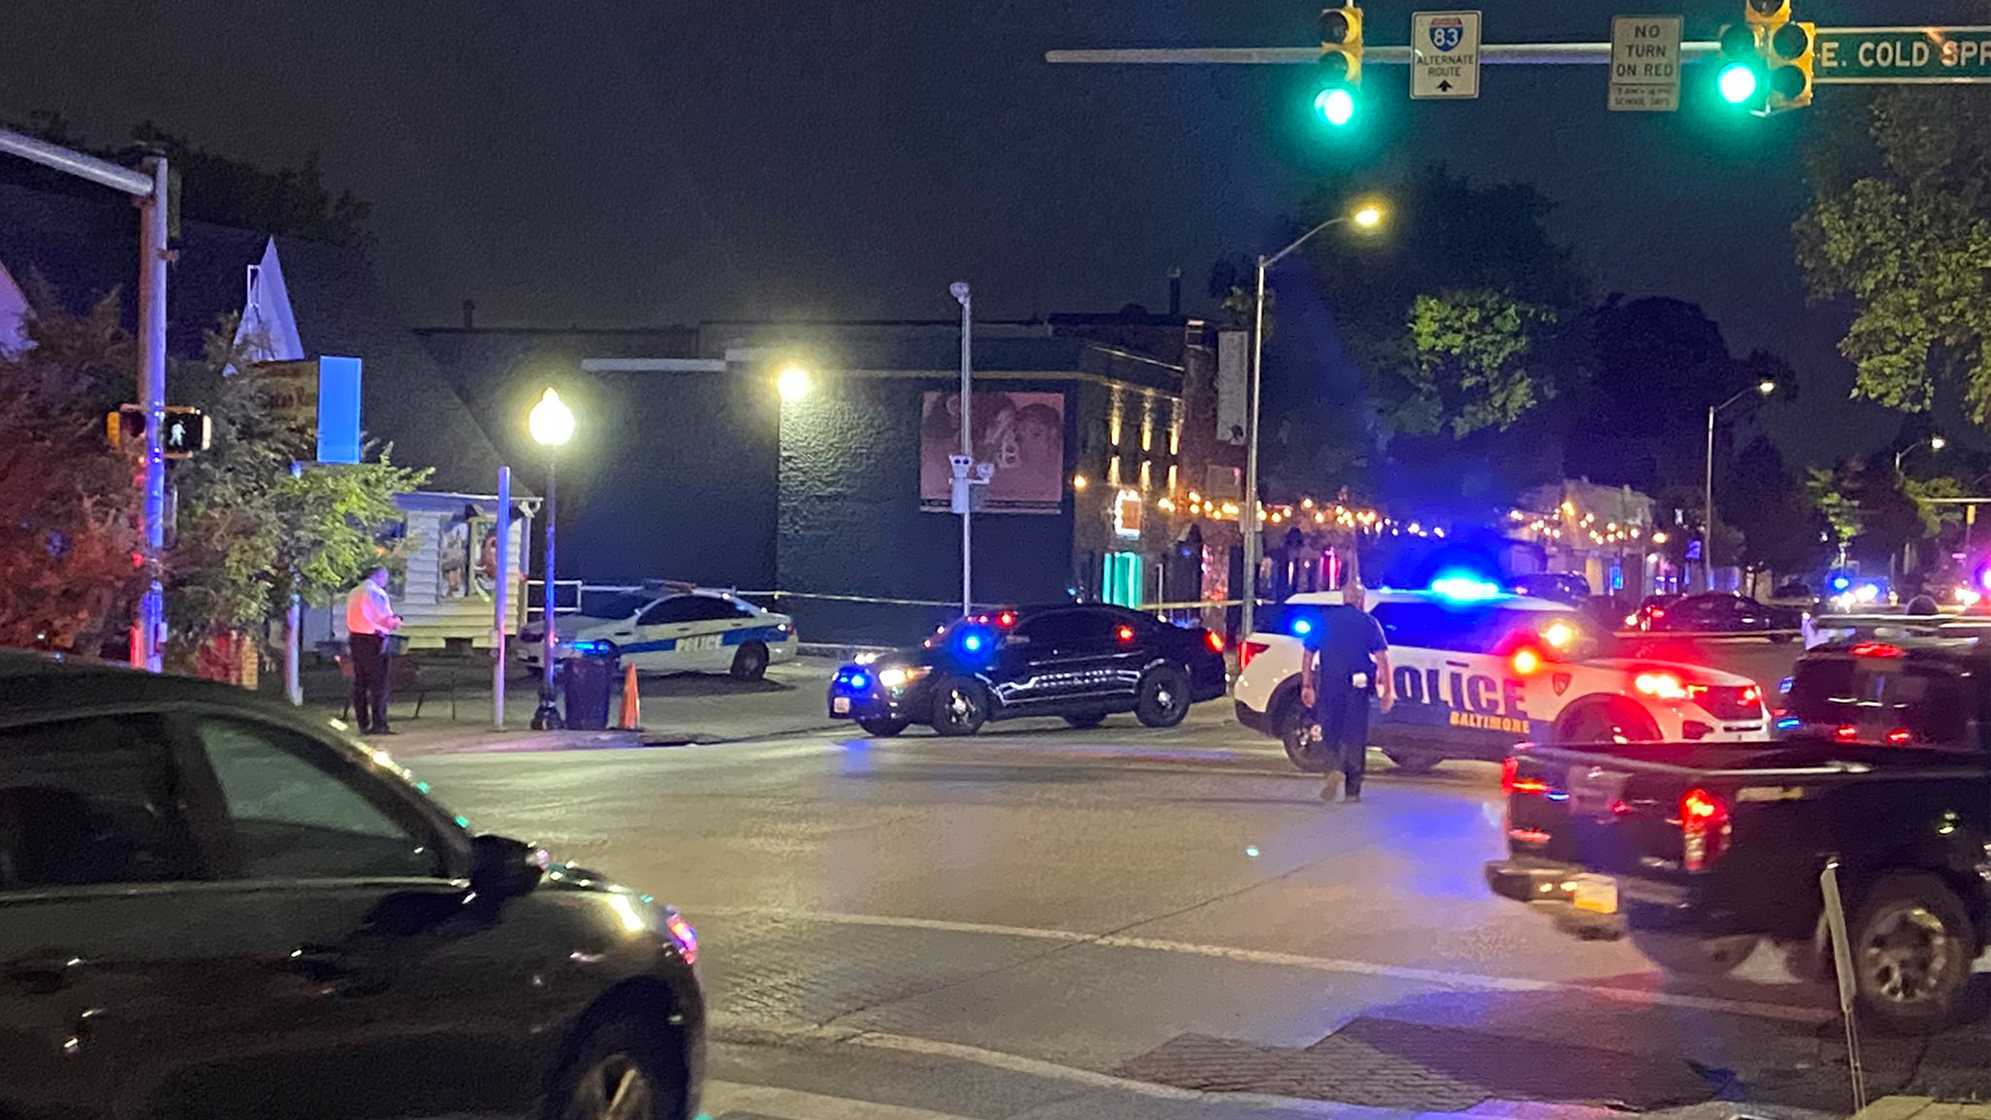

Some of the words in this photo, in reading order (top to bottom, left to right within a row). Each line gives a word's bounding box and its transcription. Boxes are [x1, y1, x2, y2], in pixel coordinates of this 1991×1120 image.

[1433, 28, 1459, 47] 83
[1634, 25, 1660, 38] NO
[1625, 44, 1666, 57] TURN
[1821, 42, 1847, 67] E.
[1858, 41, 1930, 67] COLD
[1417, 54, 1475, 65] ALTERNATE
[1427, 66, 1462, 77] ROUTE
[1616, 64, 1637, 77] ON
[1643, 63, 1674, 77] RED
[675, 634, 723, 653] POLICE
[1393, 665, 1530, 719] OLICE
[1450, 710, 1531, 734] BALTIMORE
